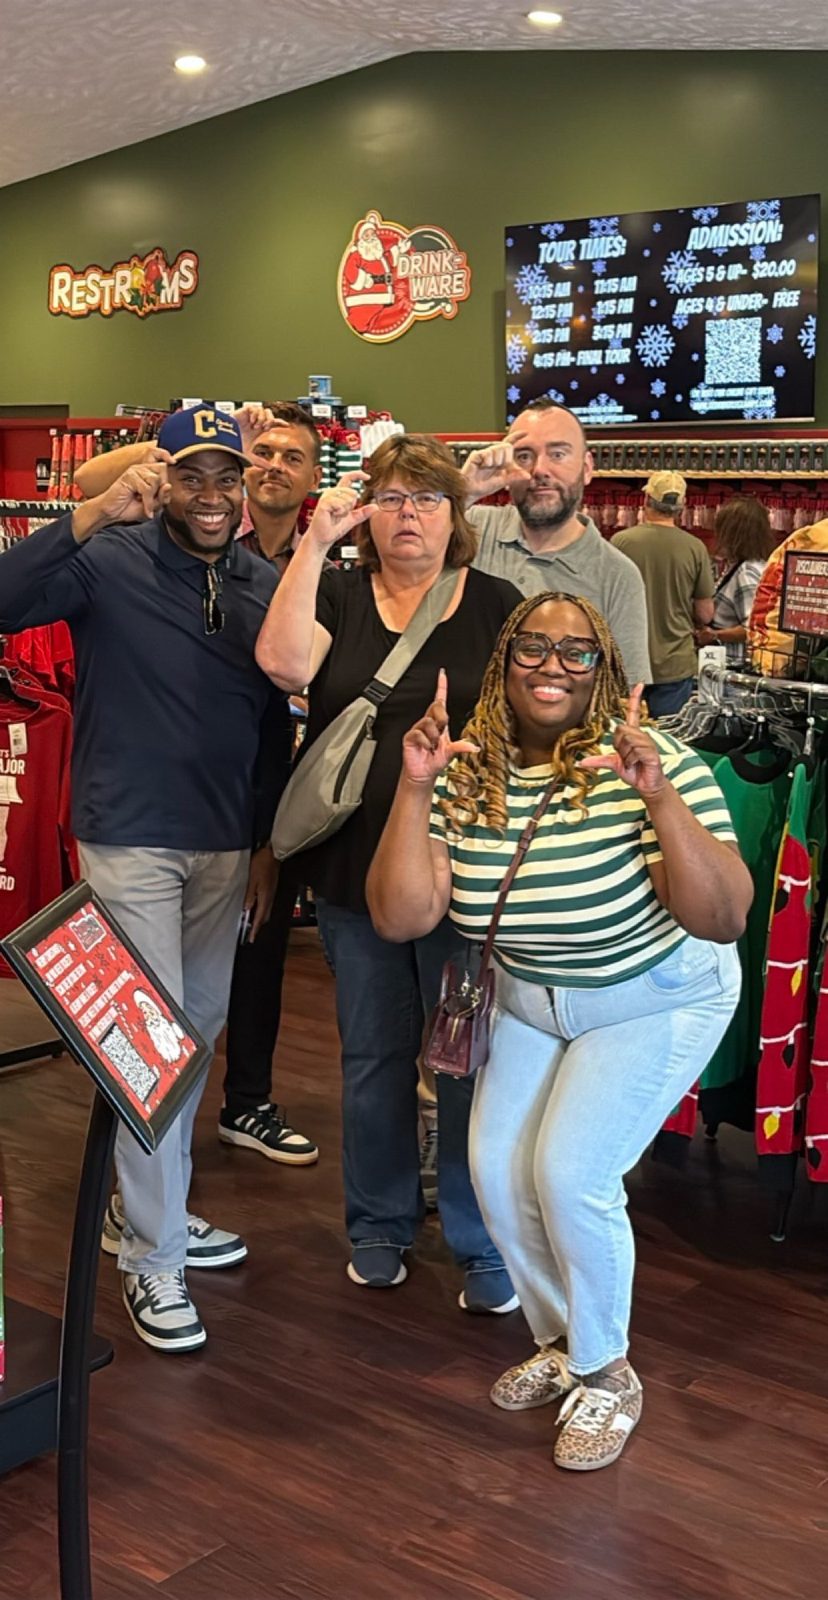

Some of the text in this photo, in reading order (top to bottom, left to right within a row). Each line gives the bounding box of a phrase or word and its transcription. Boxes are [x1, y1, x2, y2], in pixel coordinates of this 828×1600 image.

[687, 220, 784, 250] ADMISSION:
[538, 235, 627, 264] TOUR TIMES:
[675, 267, 704, 284] AGES
[705, 266, 715, 282] 5
[715, 265, 726, 282] &
[752, 259, 796, 280] $20.00
[411, 273, 465, 299] WARE
[553, 281, 572, 298] AM
[619, 275, 638, 292] AM
[556, 302, 574, 318] PM
[617, 297, 634, 314] PM
[674, 298, 704, 315] AGES
[715, 296, 726, 312] &
[726, 293, 769, 311] UNDER-
[772, 290, 800, 308] FREE
[554, 327, 571, 343] PM
[615, 322, 633, 339] PM
[576, 350, 603, 366] FINAL
[604, 348, 631, 365] TOUR
[193, 410, 217, 438] C
[704, 651, 715, 660] XL
